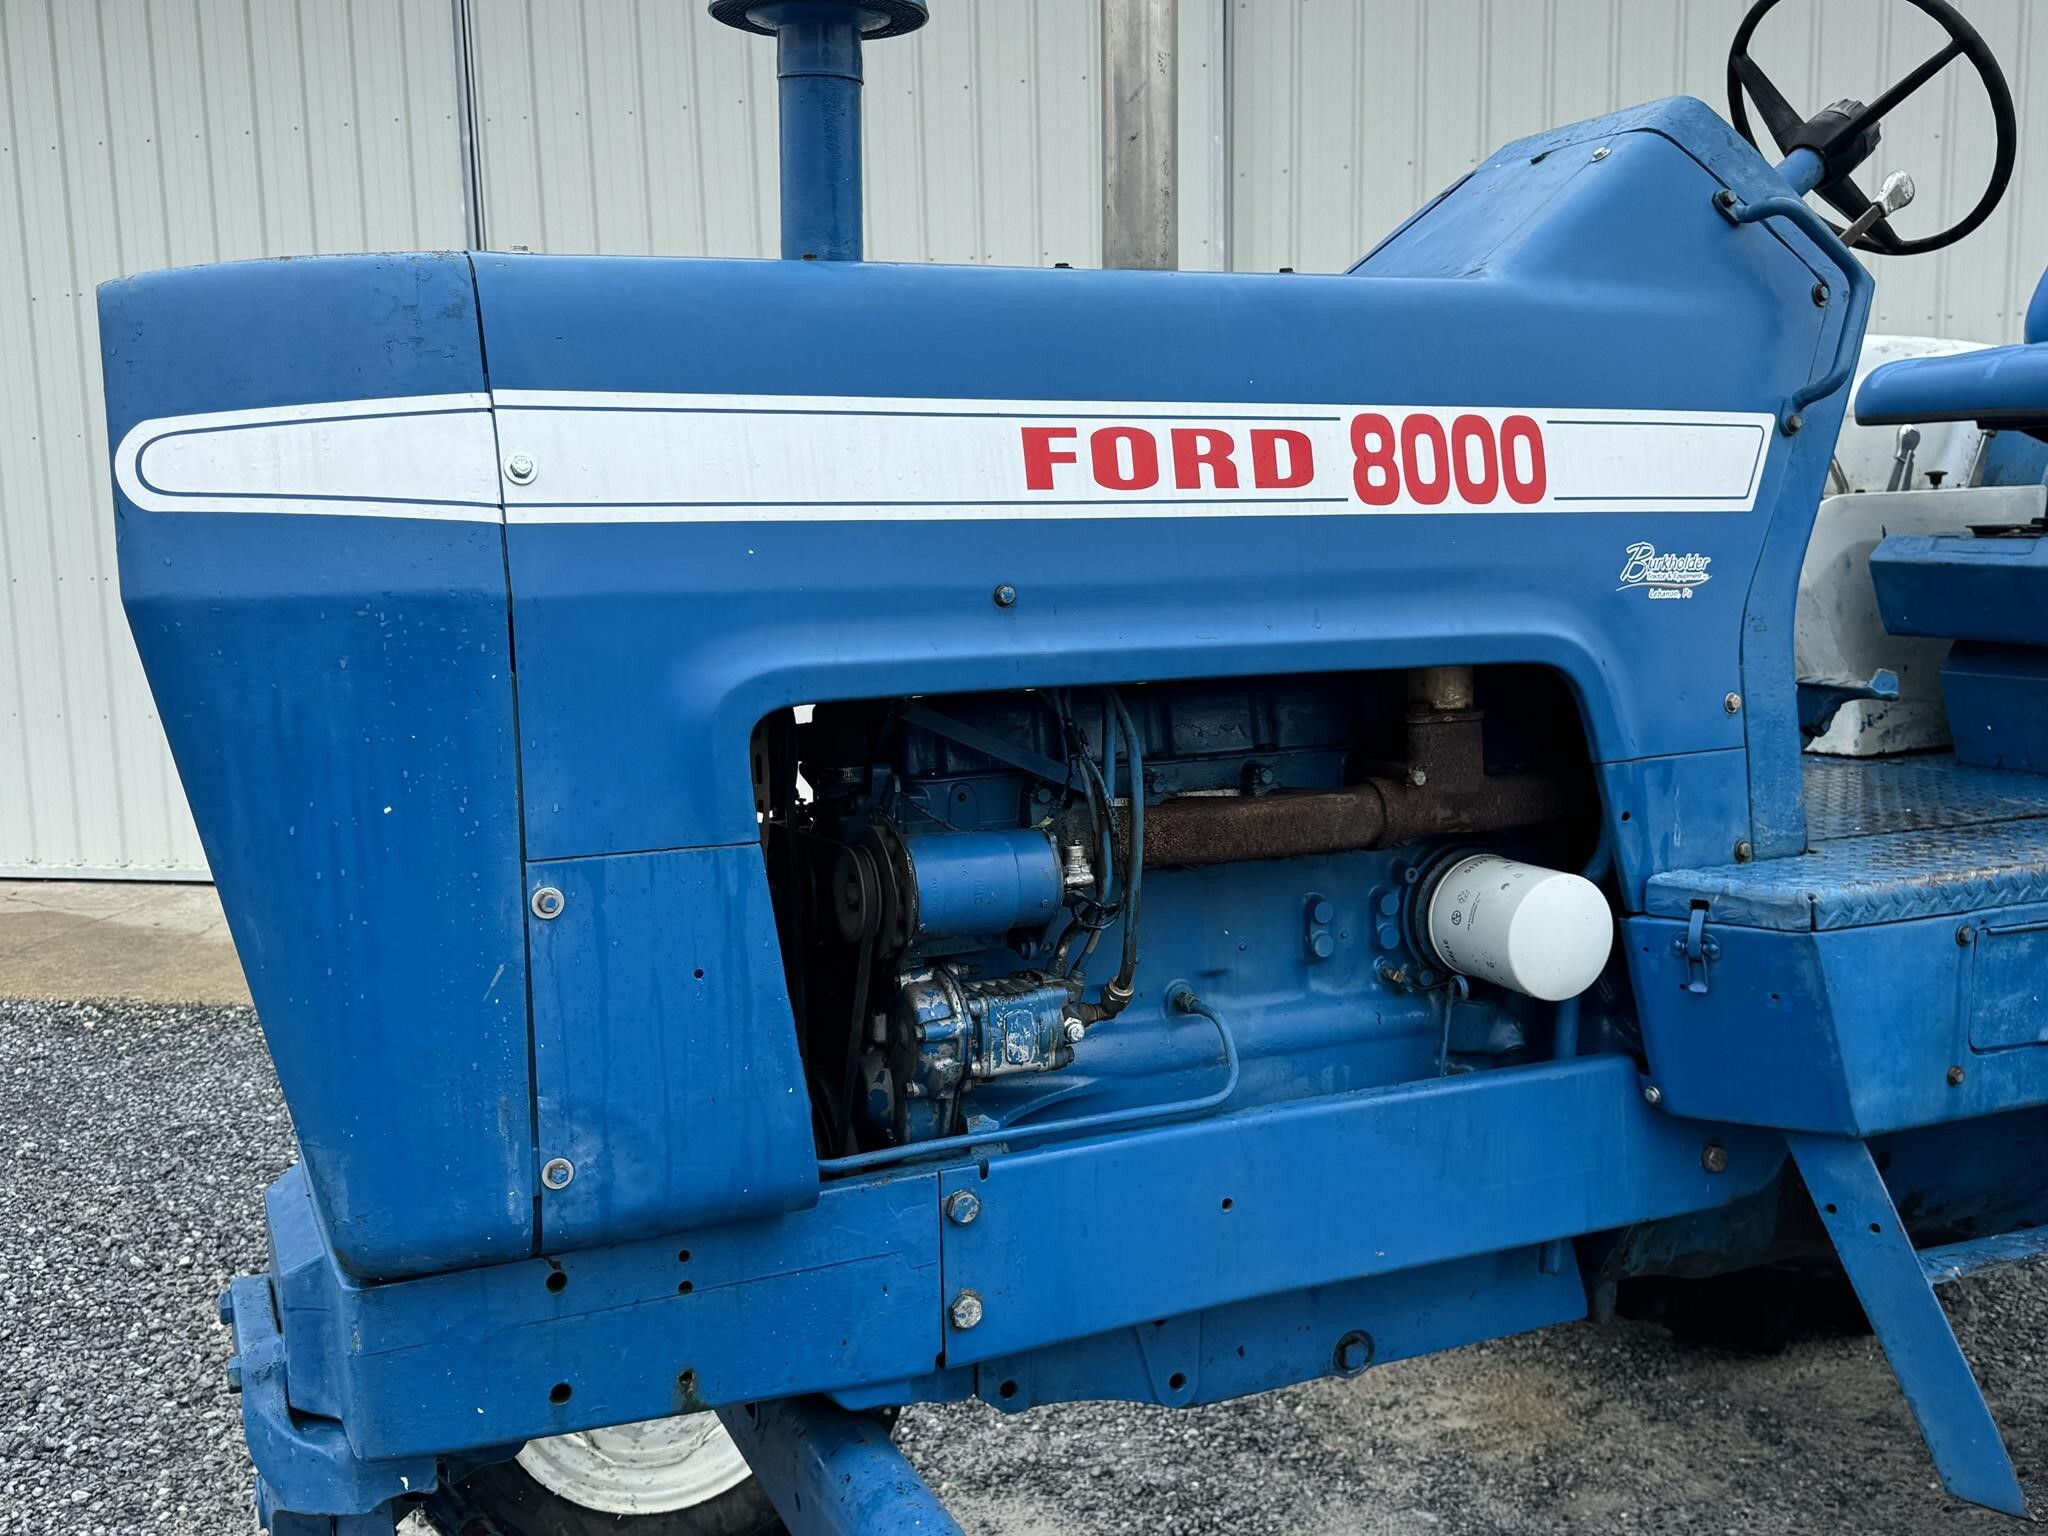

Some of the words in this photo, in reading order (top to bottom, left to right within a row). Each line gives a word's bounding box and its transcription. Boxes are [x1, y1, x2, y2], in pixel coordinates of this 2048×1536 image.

[1021, 427, 1314, 491] FORD
[1350, 413, 1547, 506] 8000
[1620, 542, 1711, 582] Burkholder
